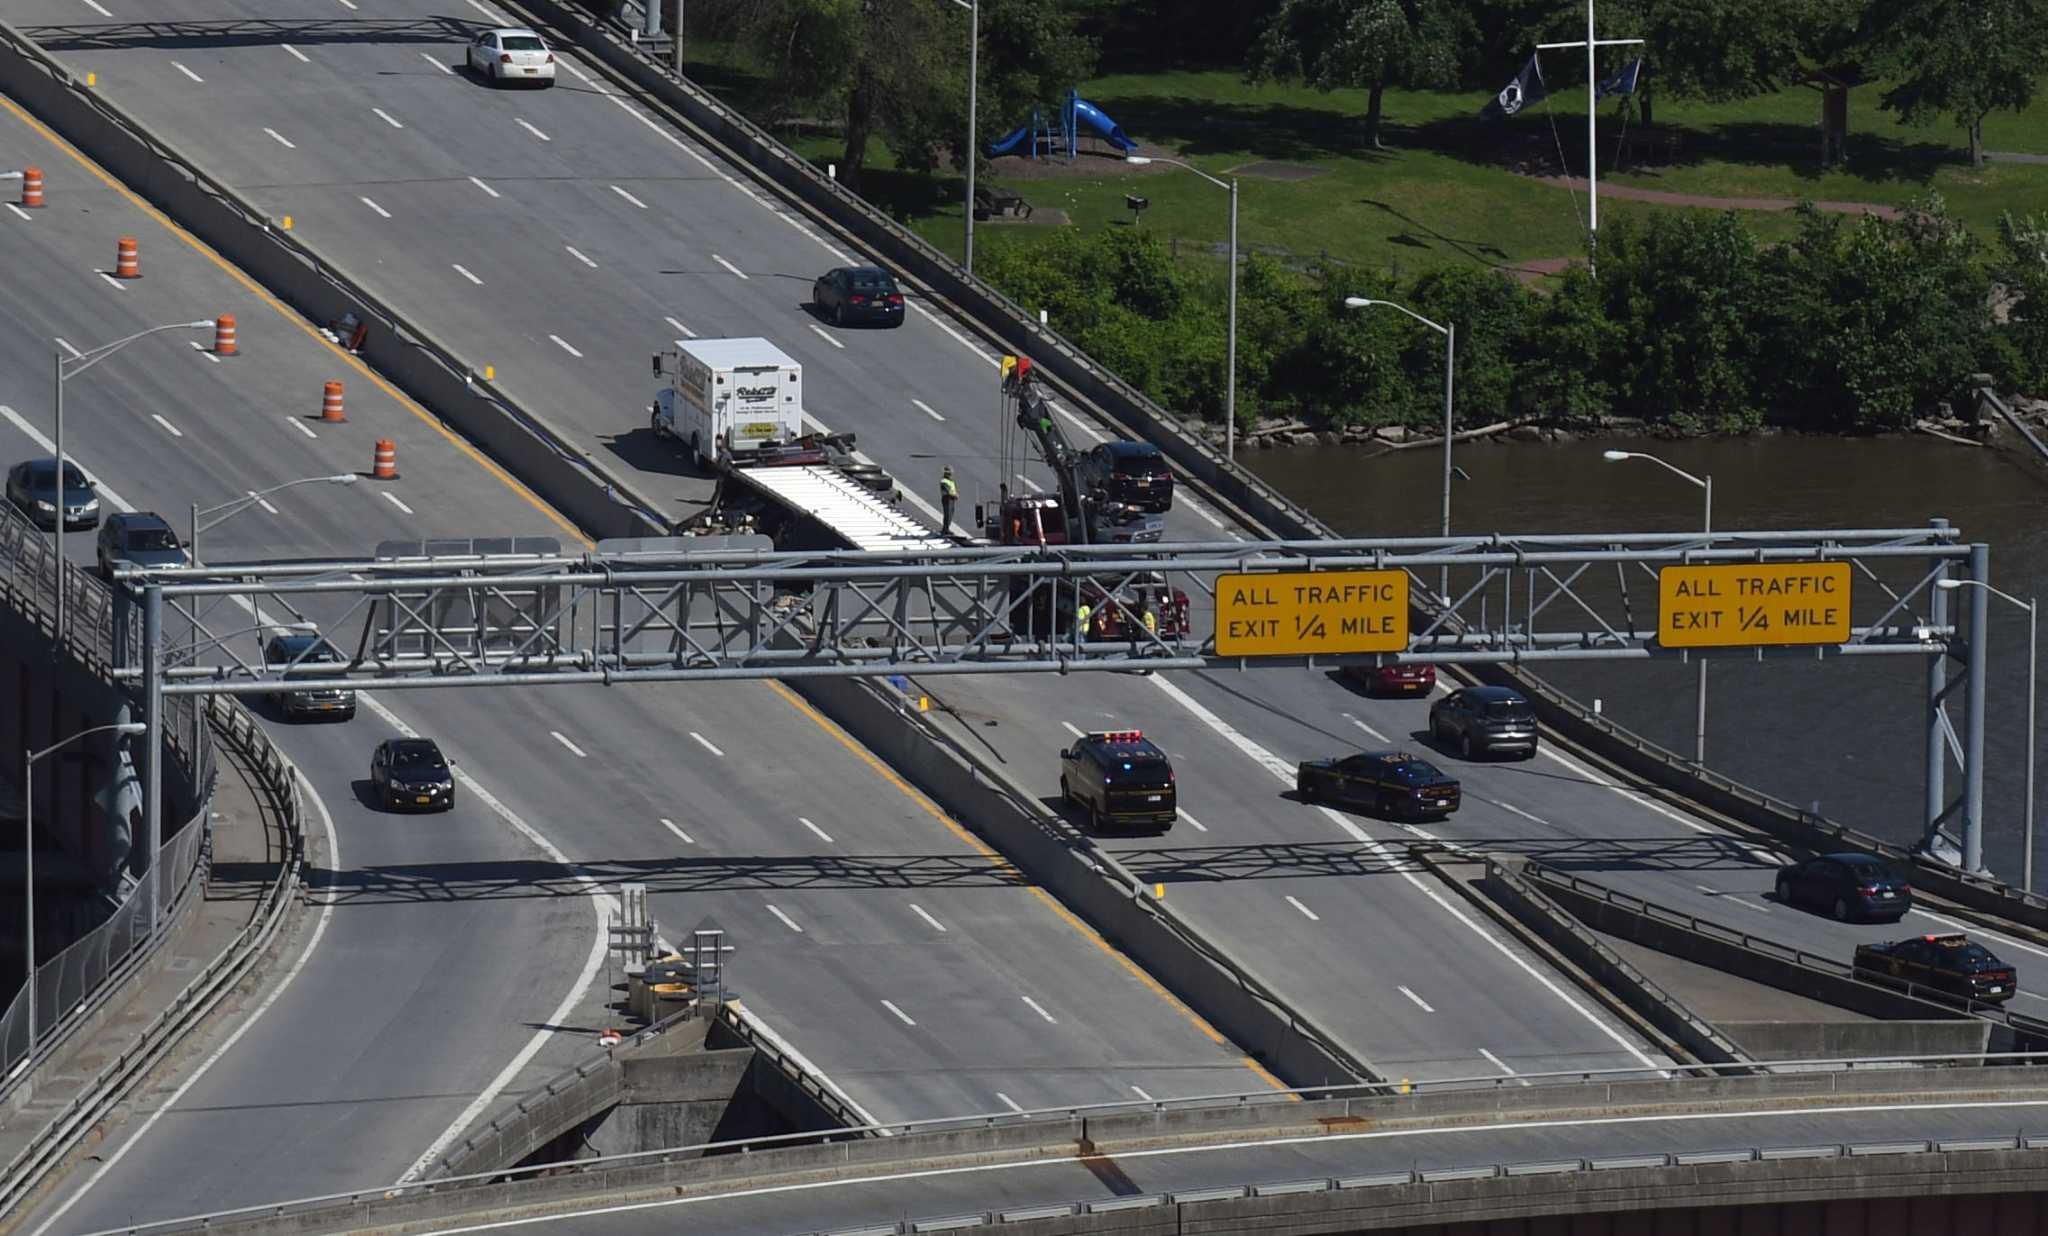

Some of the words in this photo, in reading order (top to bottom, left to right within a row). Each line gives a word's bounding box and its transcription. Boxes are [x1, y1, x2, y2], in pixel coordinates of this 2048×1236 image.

[1233, 589, 1279, 606] ALL
[1294, 584, 1394, 604] TRAFFIC
[1676, 579, 1721, 596] ALL
[1736, 576, 1835, 595] TRAFFIC
[1229, 620, 1280, 638] EXIT
[1341, 616, 1395, 635] MILE
[1672, 611, 1723, 629] EXIT
[1784, 609, 1838, 626] MILE
